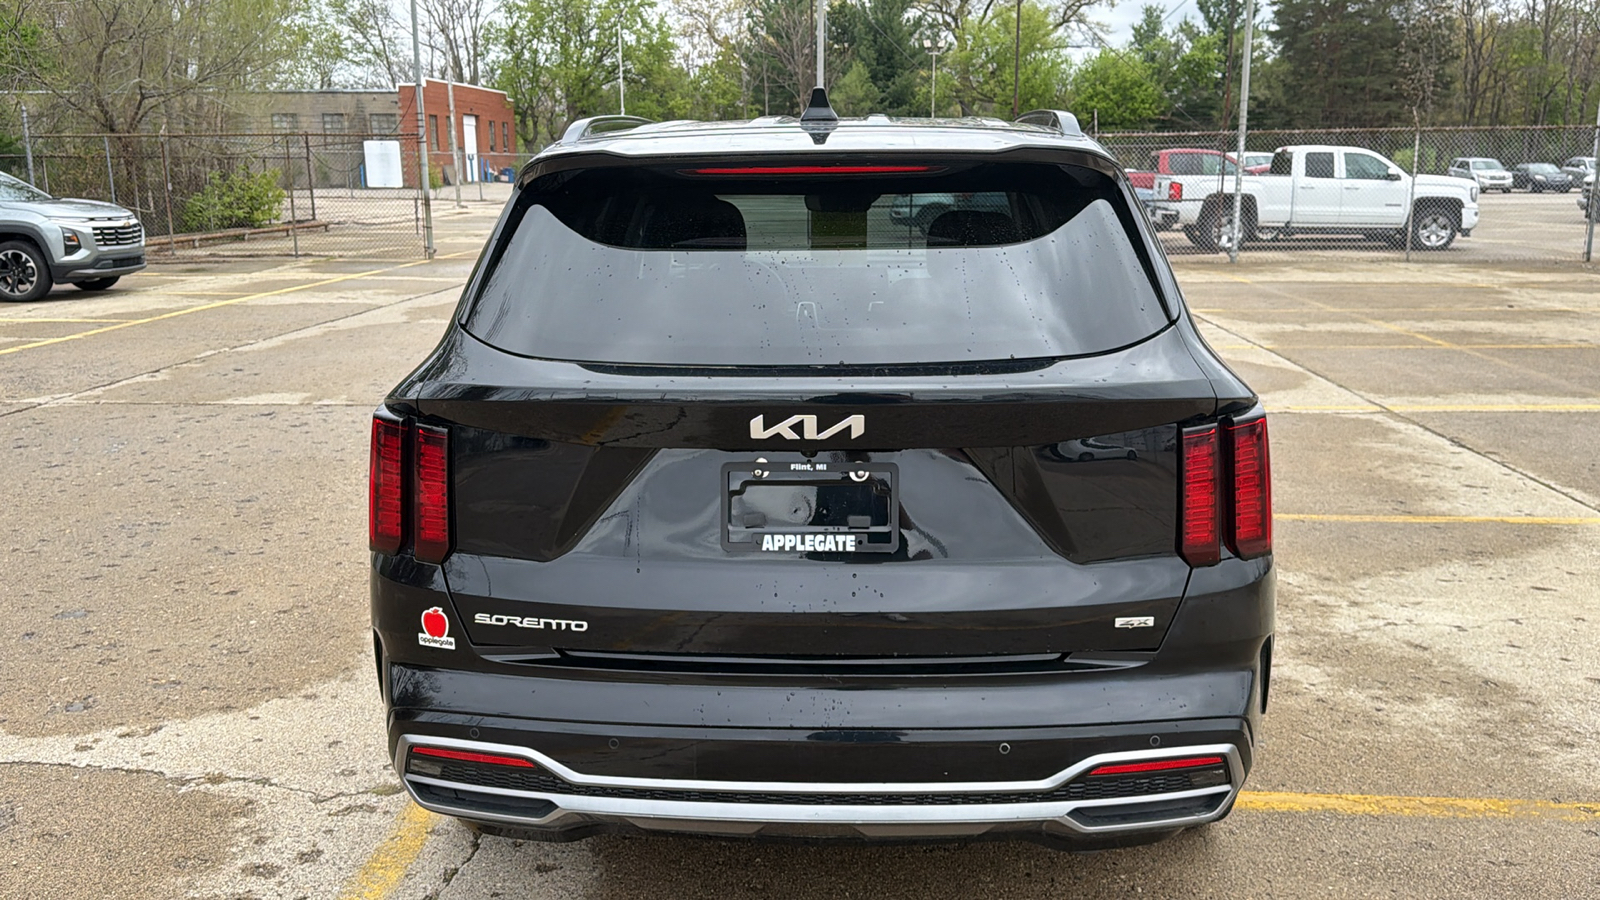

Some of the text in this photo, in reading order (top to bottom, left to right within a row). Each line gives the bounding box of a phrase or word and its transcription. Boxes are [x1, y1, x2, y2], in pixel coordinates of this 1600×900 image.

[750, 414, 865, 440] KIA
[790, 463, 827, 471] Flint, MI
[761, 534, 856, 551] APPLEGATE
[474, 613, 588, 632] SORENTO
[419, 636, 454, 647] applegate
